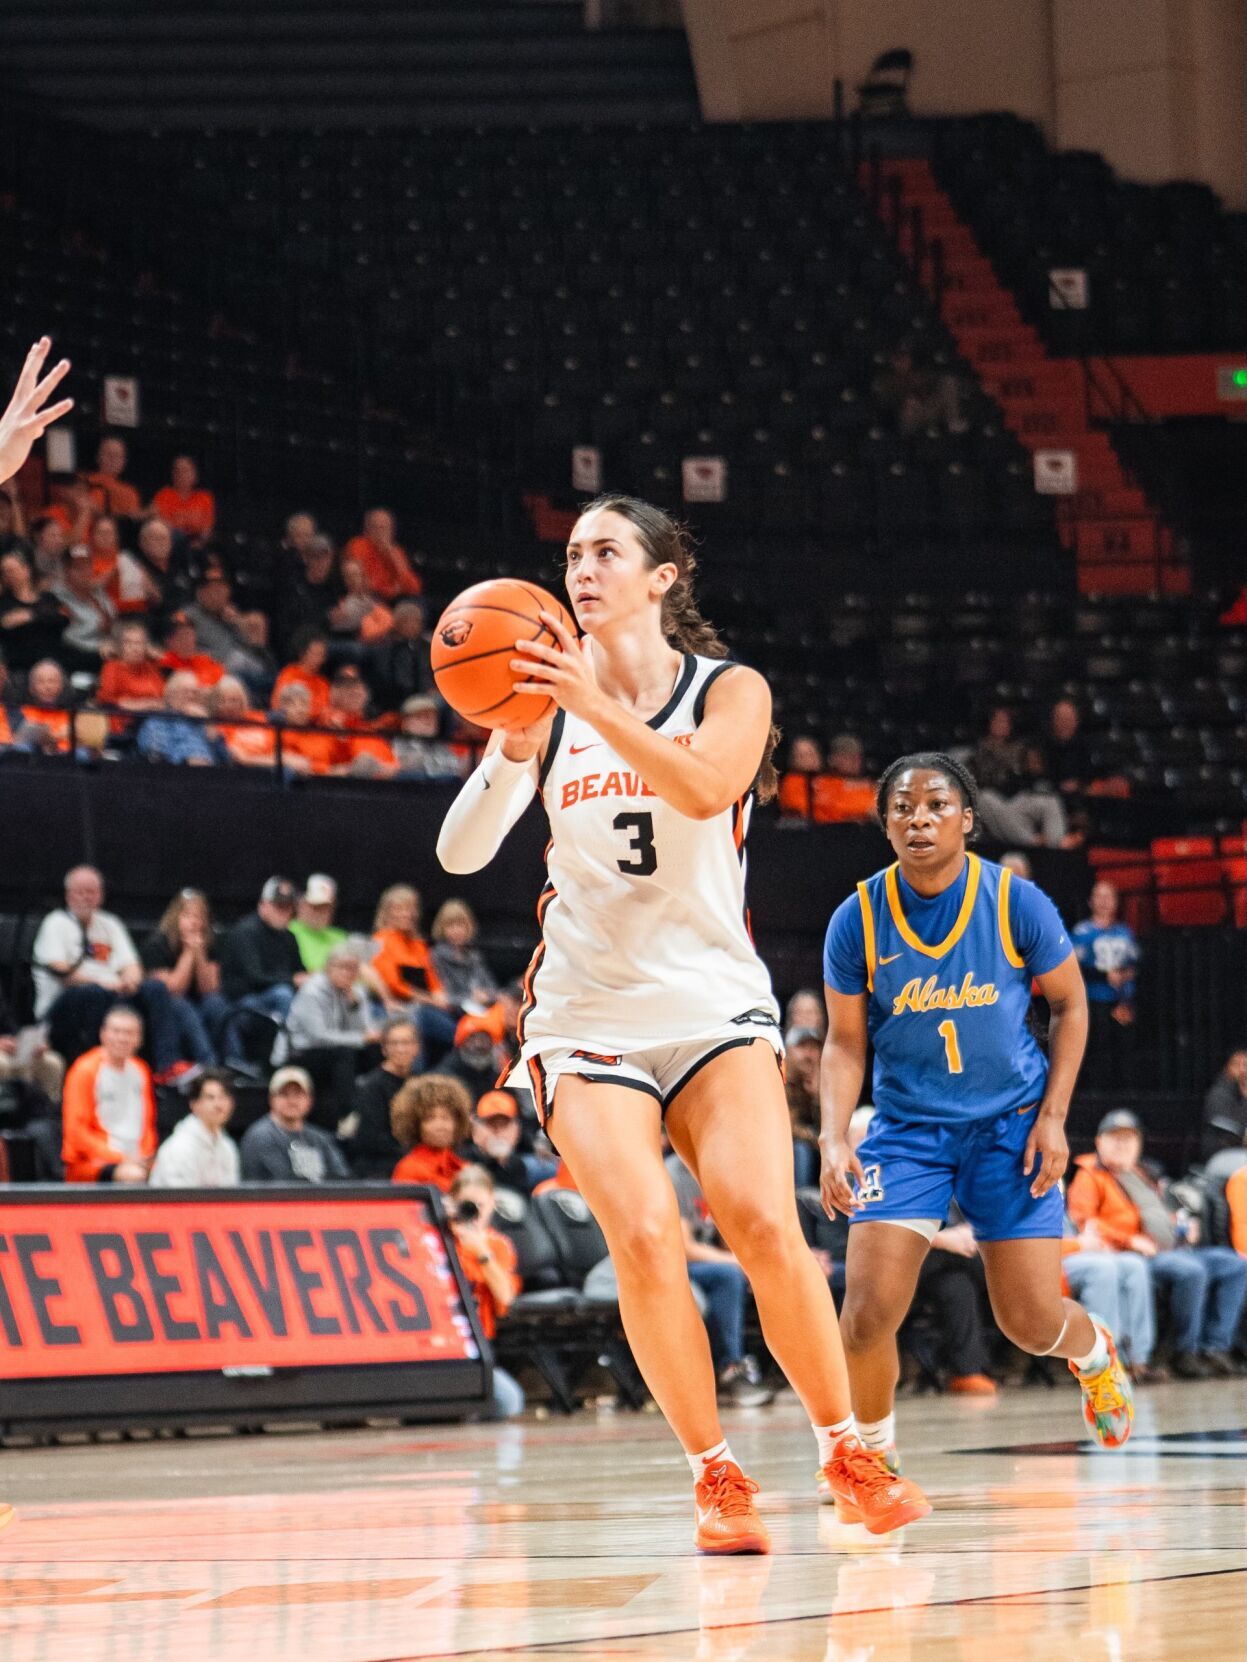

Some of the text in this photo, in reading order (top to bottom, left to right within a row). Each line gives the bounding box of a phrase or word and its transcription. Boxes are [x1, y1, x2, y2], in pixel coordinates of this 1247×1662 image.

[613, 812, 657, 876] 3
[893, 971, 999, 1015] Alaska
[938, 1020, 963, 1074] 1
[83, 1228, 432, 1343] BEAVERS
